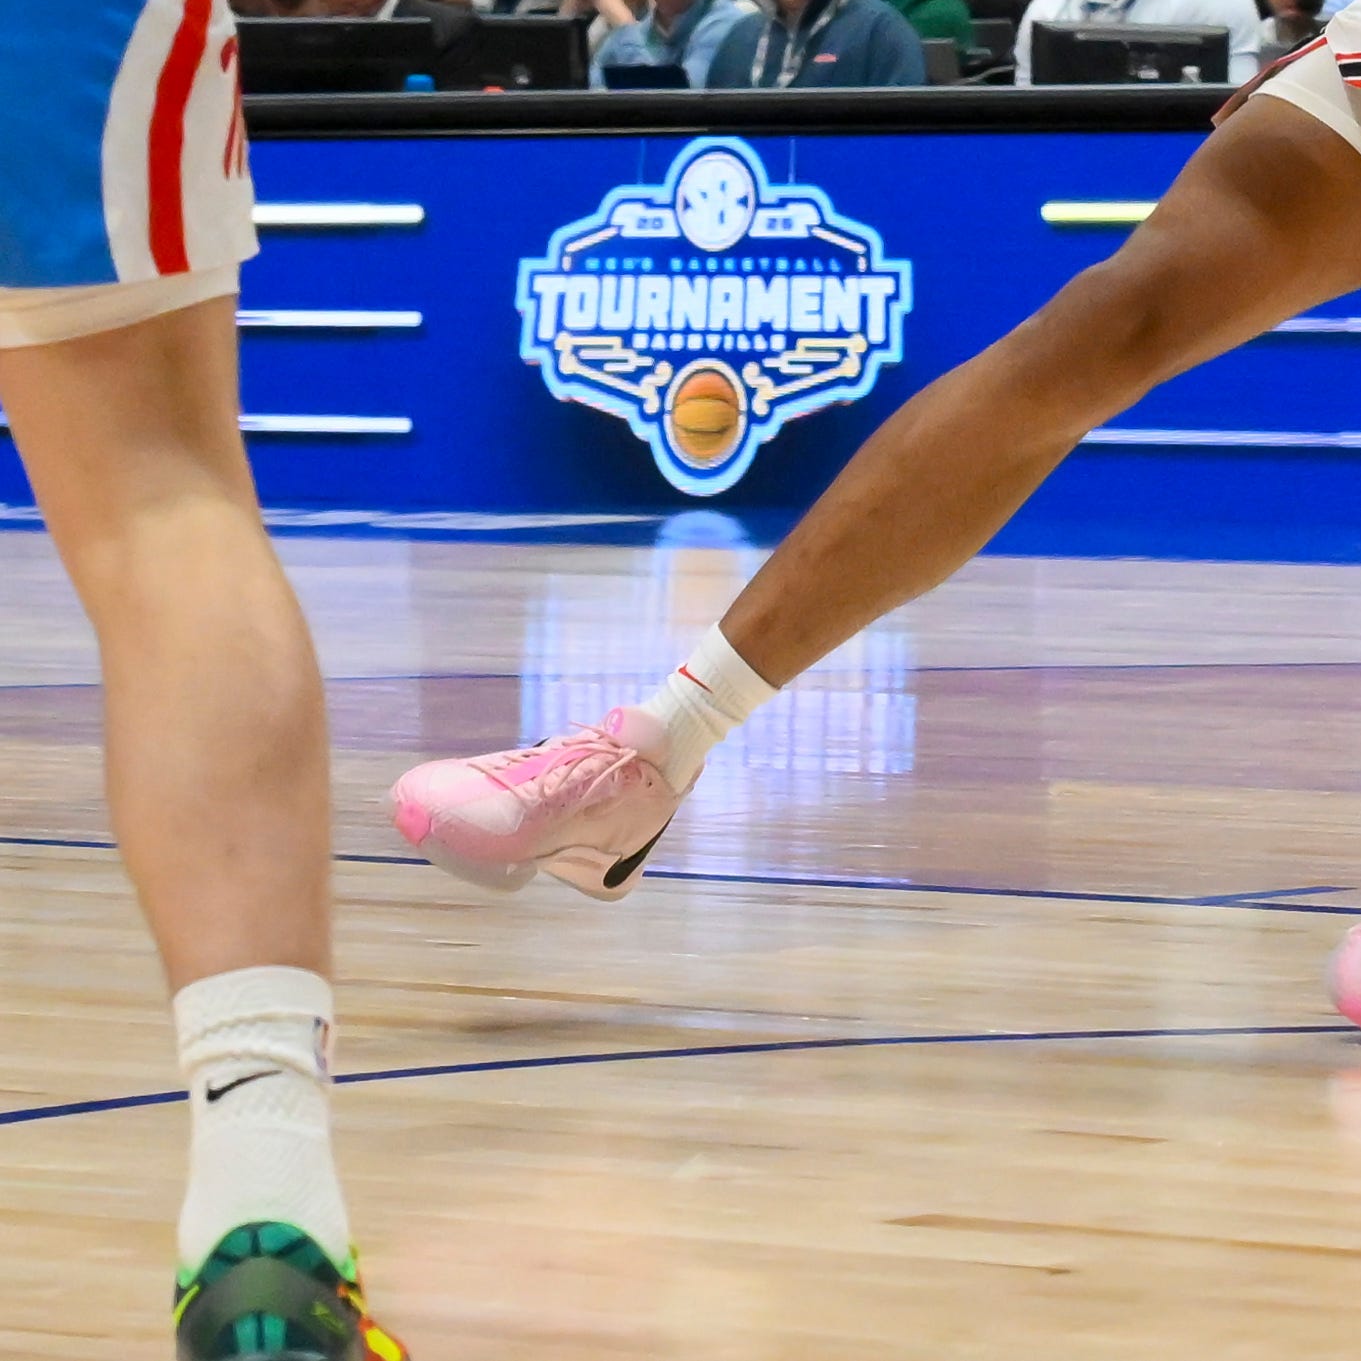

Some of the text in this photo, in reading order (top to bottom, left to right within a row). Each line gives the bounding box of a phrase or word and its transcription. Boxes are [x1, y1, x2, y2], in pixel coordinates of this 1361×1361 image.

[669, 256, 843, 274] BASKETBALL
[532, 273, 897, 345] TOURNAMENT
[631, 331, 788, 353] NASHVILLE
